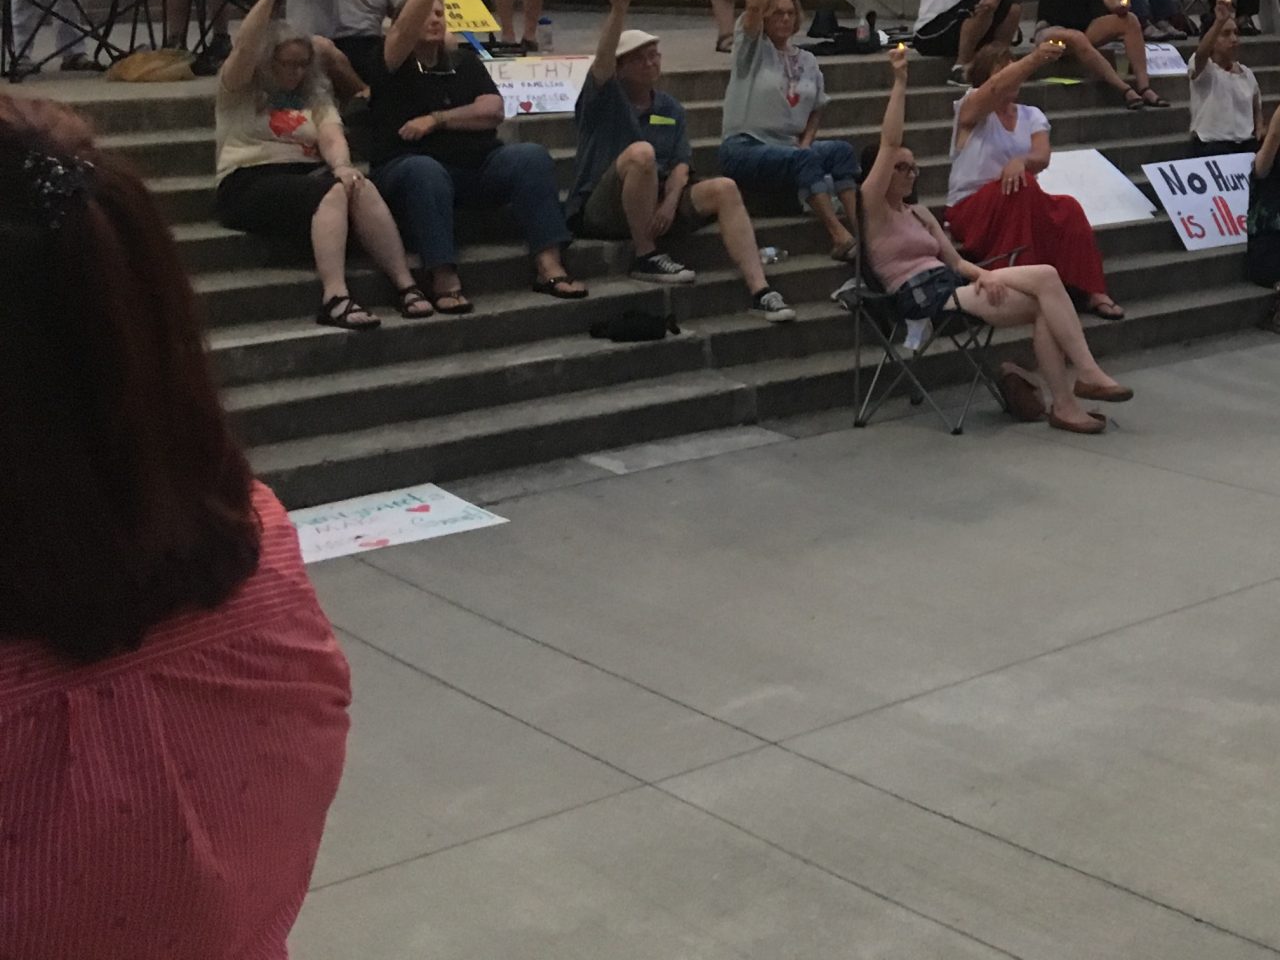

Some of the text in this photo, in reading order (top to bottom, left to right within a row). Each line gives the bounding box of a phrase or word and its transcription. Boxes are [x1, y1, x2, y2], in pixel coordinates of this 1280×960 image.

[526, 62, 573, 79] THY
[1157, 163, 1207, 195] No
[1177, 210, 1206, 239] is
